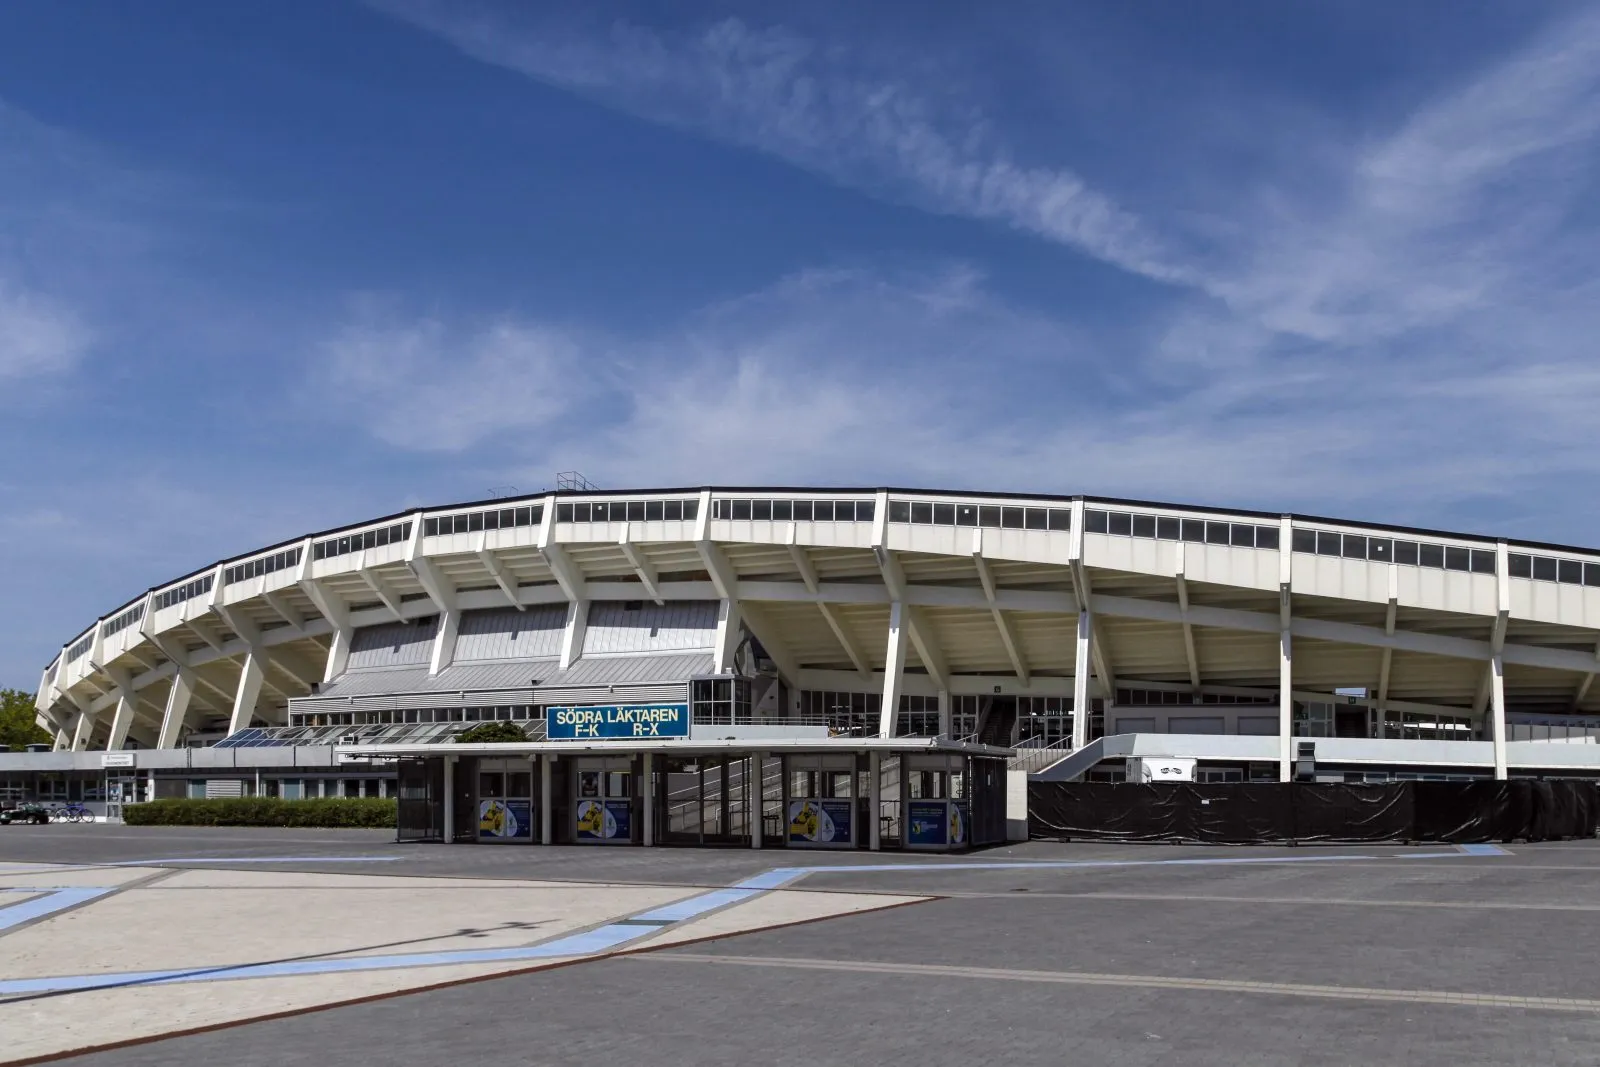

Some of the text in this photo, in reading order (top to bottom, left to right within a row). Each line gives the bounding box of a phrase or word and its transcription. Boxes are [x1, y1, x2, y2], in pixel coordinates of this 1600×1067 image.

[556, 707, 678, 725] SÖDRA LÄKTAREN
[575, 723, 659, 736] F-K R-X
